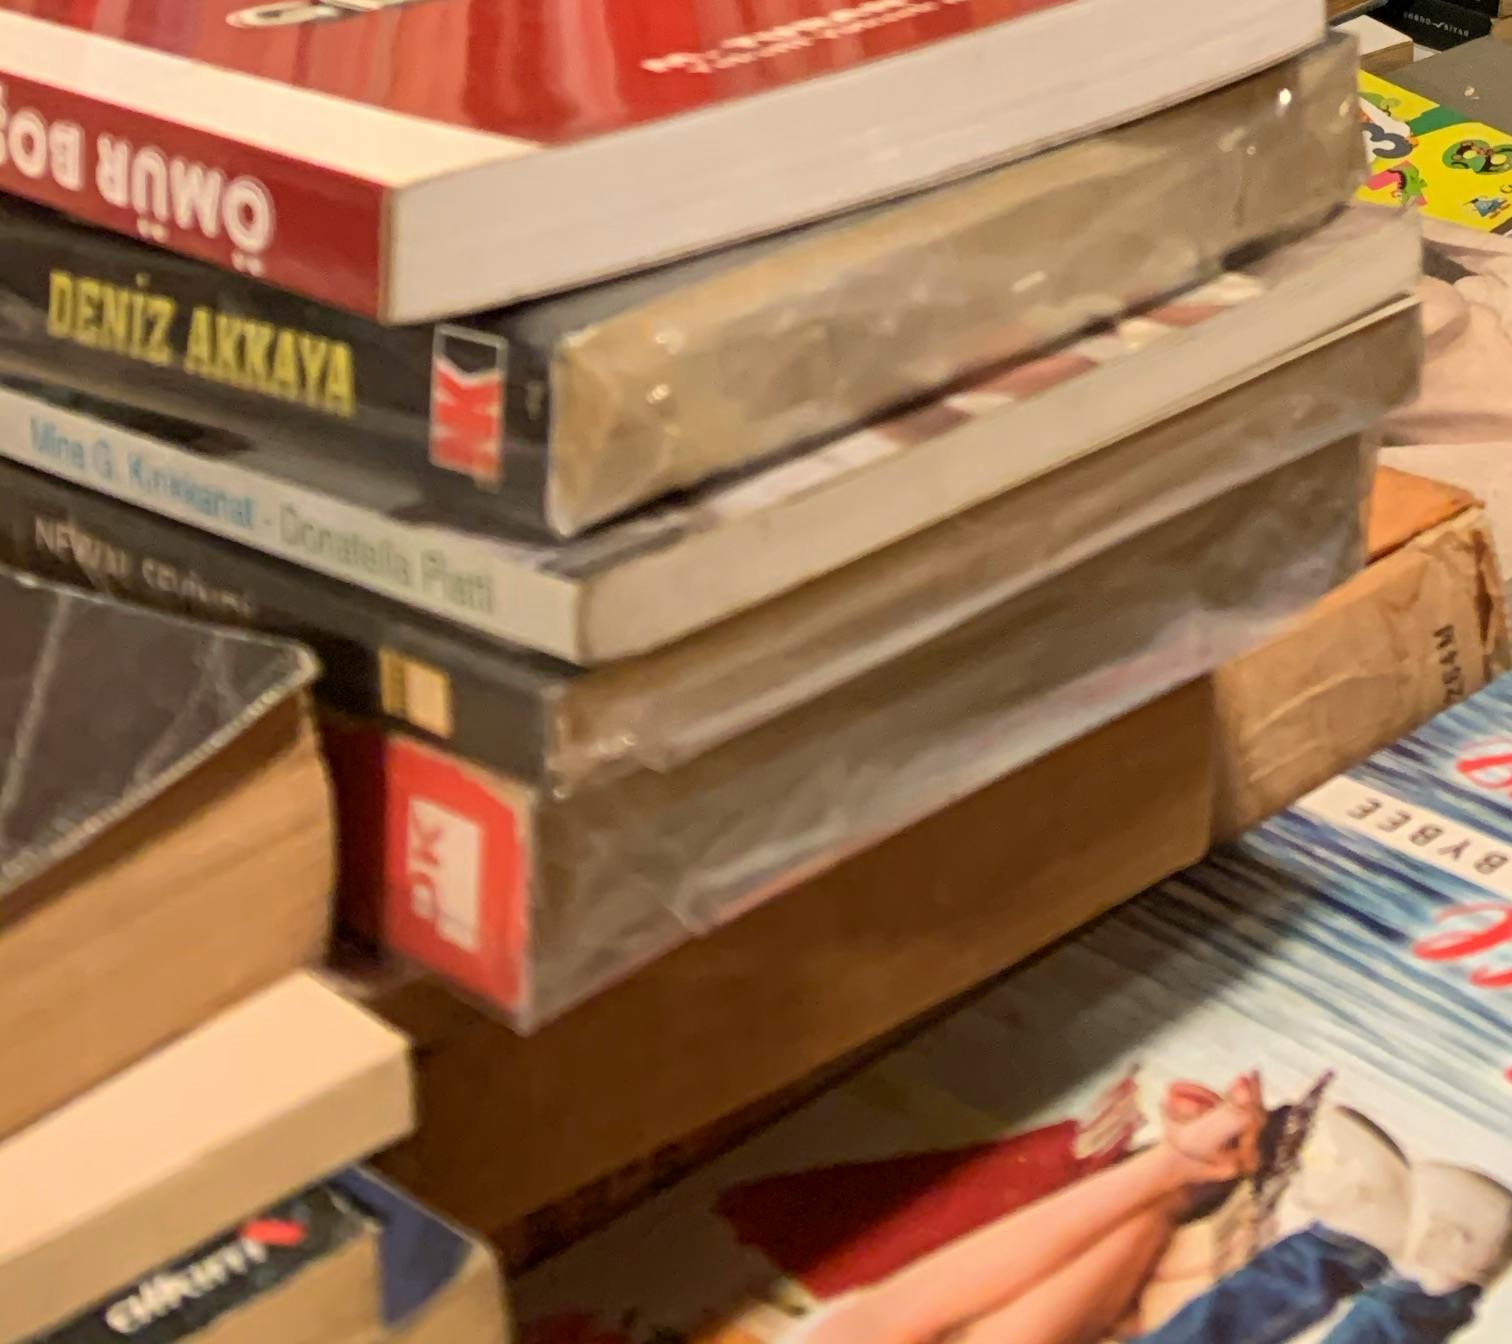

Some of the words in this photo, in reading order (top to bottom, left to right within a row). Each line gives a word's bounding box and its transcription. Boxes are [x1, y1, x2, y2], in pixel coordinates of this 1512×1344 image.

[96, 134, 276, 277] ÖMÜR
[45, 267, 176, 368] DENİZ
[184, 305, 355, 419] AKKAYA
